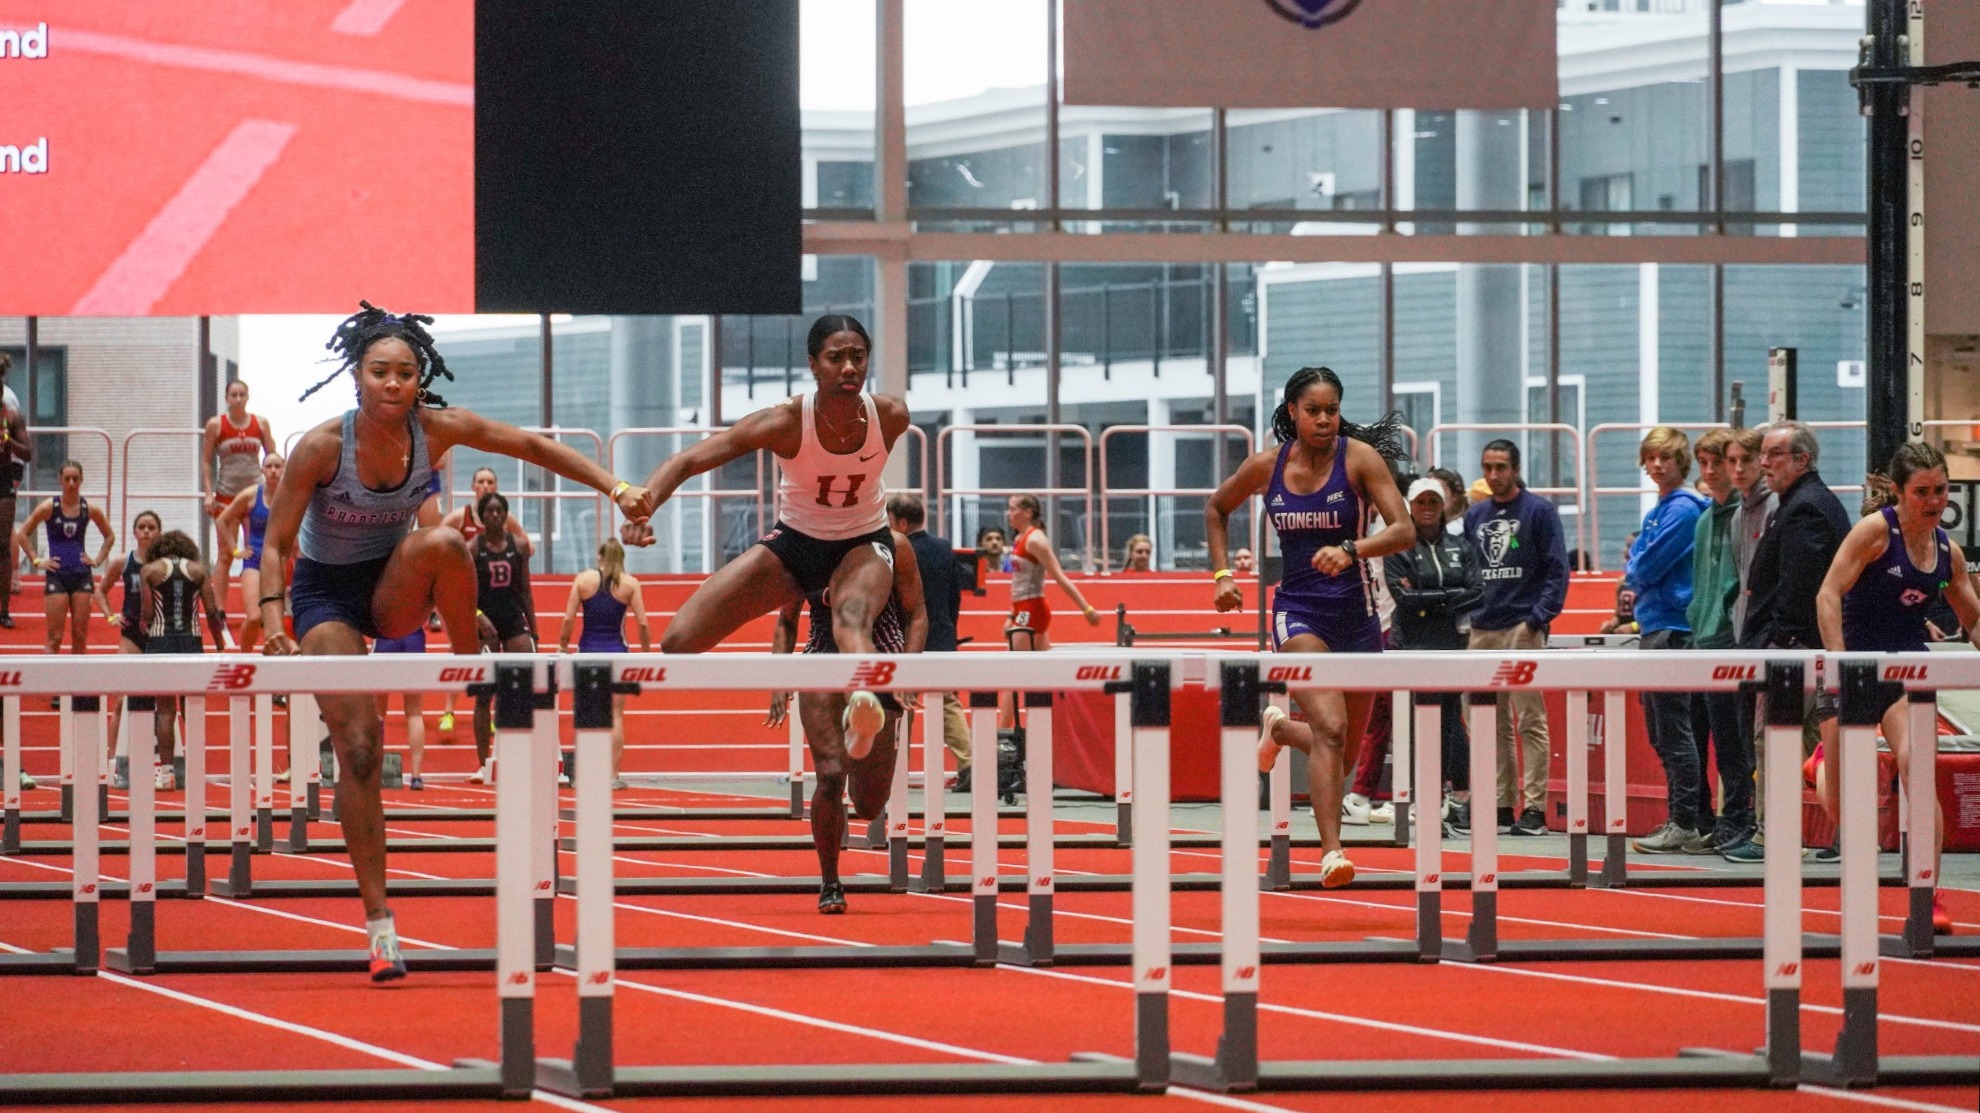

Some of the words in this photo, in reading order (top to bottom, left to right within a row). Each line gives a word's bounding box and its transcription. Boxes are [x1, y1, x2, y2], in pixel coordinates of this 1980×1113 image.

[1911, 139, 1923, 160] 10
[1911, 282, 1923, 296] 8
[1911, 352, 1923, 366] 7
[1911, 421, 1923, 436] 6
[815, 473, 866, 507] H
[1327, 491, 1344, 503] NEC
[1275, 511, 1342, 530] STONEHILL
[489, 561, 511, 587] B
[438, 667, 484, 683] GILL
[620, 667, 667, 683] GILL
[1075, 665, 1121, 681] GILL
[1267, 665, 1313, 681] GILL
[1711, 665, 1756, 681] GILL
[1884, 665, 1928, 681] GILL
